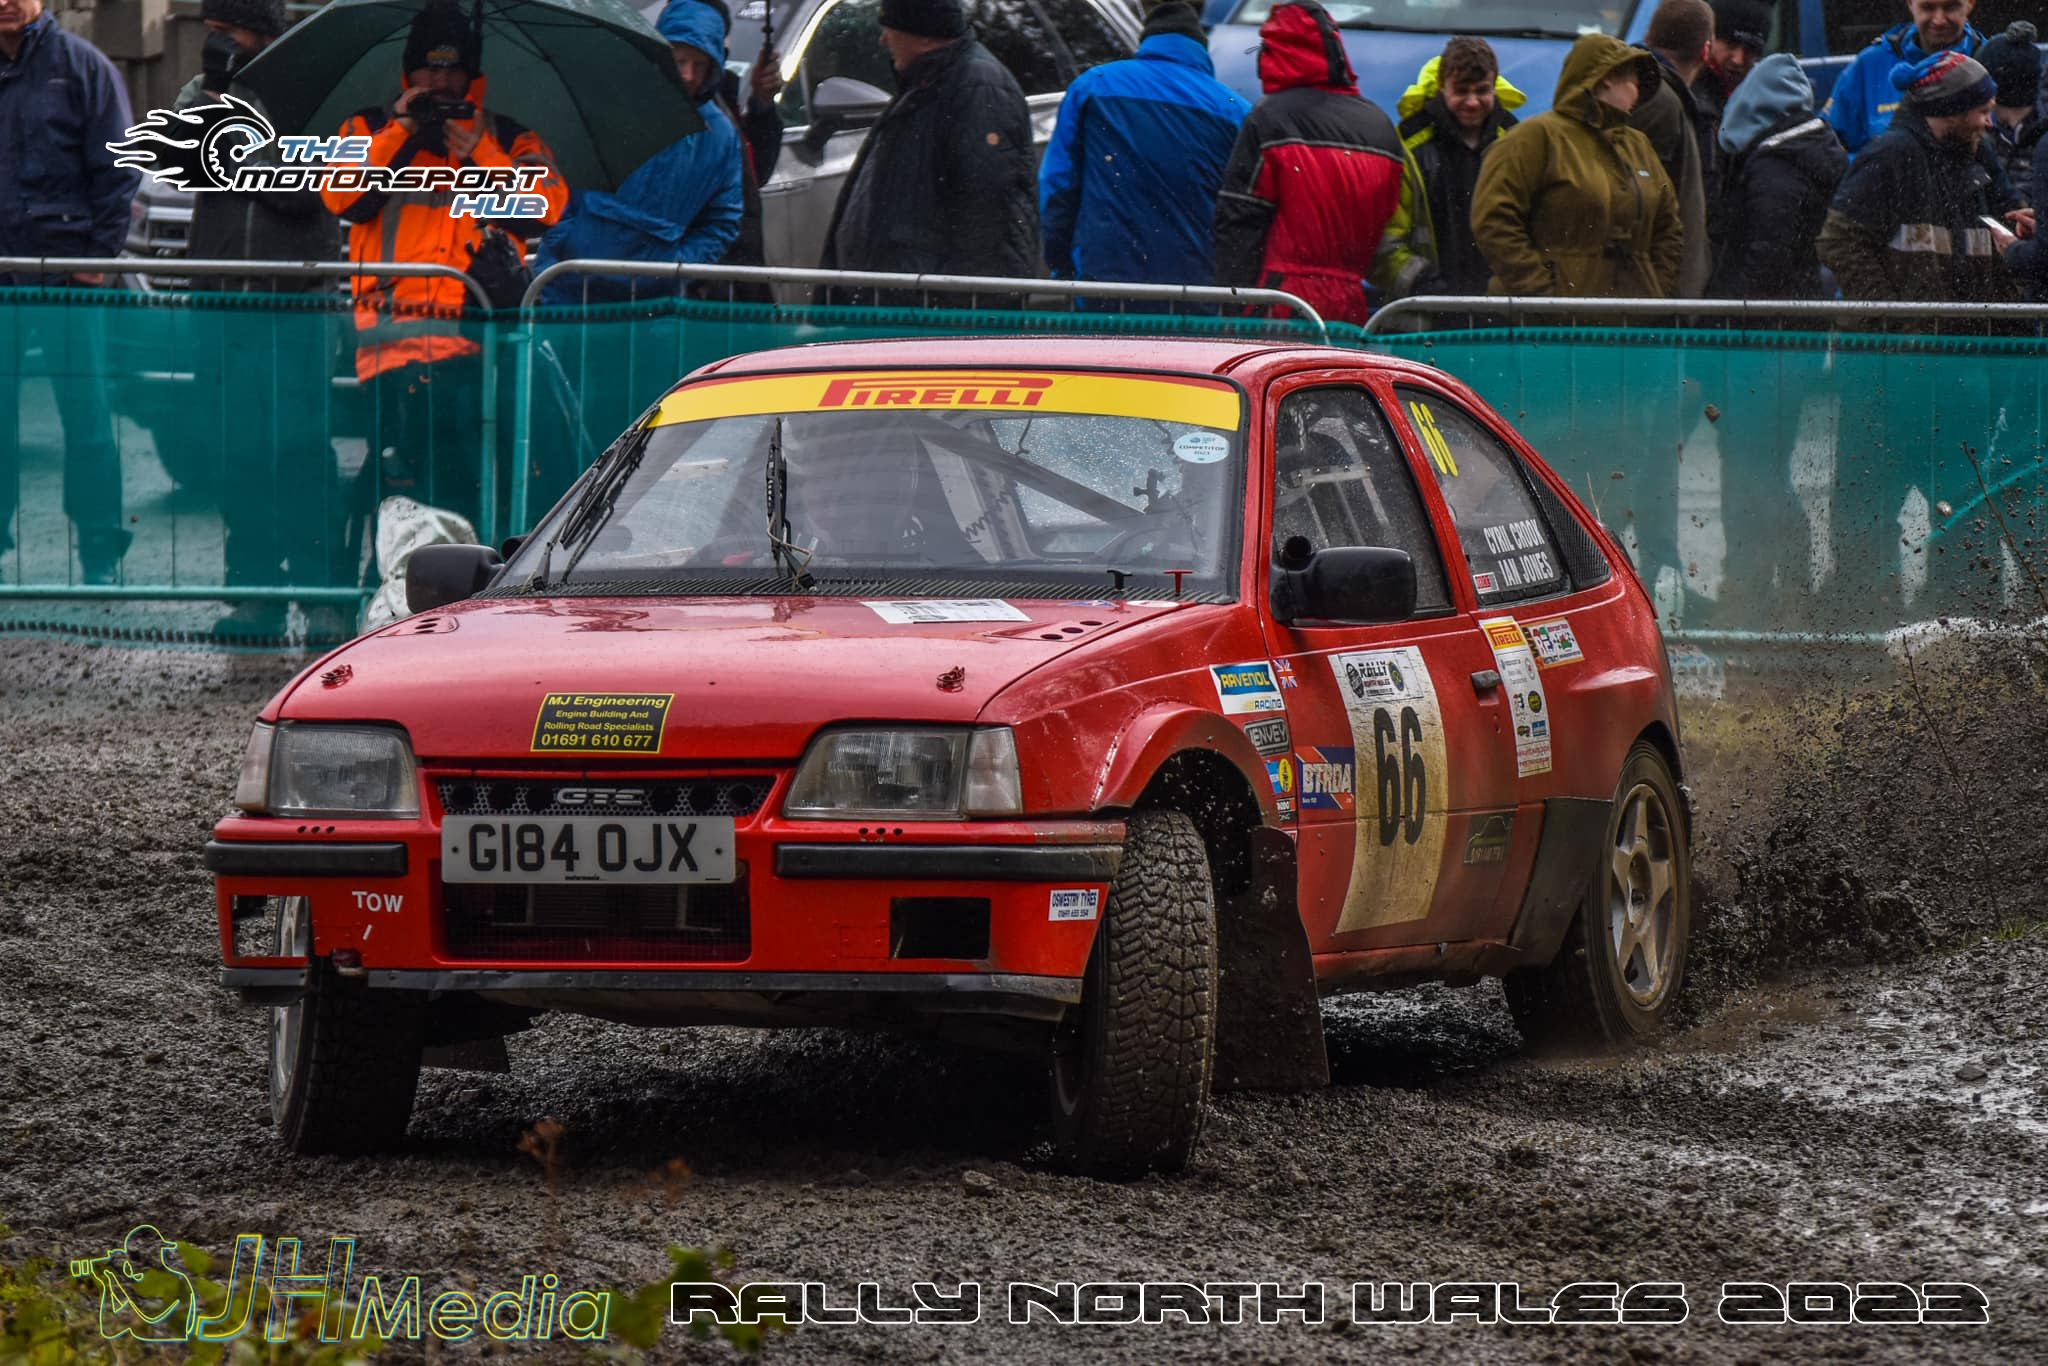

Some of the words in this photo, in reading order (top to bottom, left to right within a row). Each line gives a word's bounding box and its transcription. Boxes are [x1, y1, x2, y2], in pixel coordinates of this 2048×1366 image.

[818, 376, 1054, 407] PIRELLI
[1409, 401, 1458, 477] 66
[1483, 525, 1515, 554] CYRIL
[1498, 558, 1522, 587] IAN
[1519, 551, 1553, 583] JONES
[1487, 625, 1522, 647] PIRELLI
[1220, 671, 1271, 689] RAVENOL
[548, 696, 571, 706] MJ
[573, 696, 666, 709] Engineering
[1254, 699, 1282, 710] RACING
[555, 710, 587, 719] Engine
[589, 710, 628, 719] Building
[629, 711, 649, 719] And
[544, 722, 576, 731] Rolling
[577, 722, 601, 730] Road
[603, 722, 654, 732] Specialists
[541, 734, 587, 746] 01691
[591, 734, 620, 746] 610
[623, 735, 653, 747] 677
[1302, 763, 1352, 794] BTRDA
[1373, 706, 1426, 846] 66
[556, 788, 645, 805] GTE
[468, 823, 580, 872] G184
[597, 823, 699, 872] OJX
[352, 891, 404, 912] TOW
[1052, 892, 1079, 907] OSWESTRY
[1080, 891, 1096, 906] TYRES
